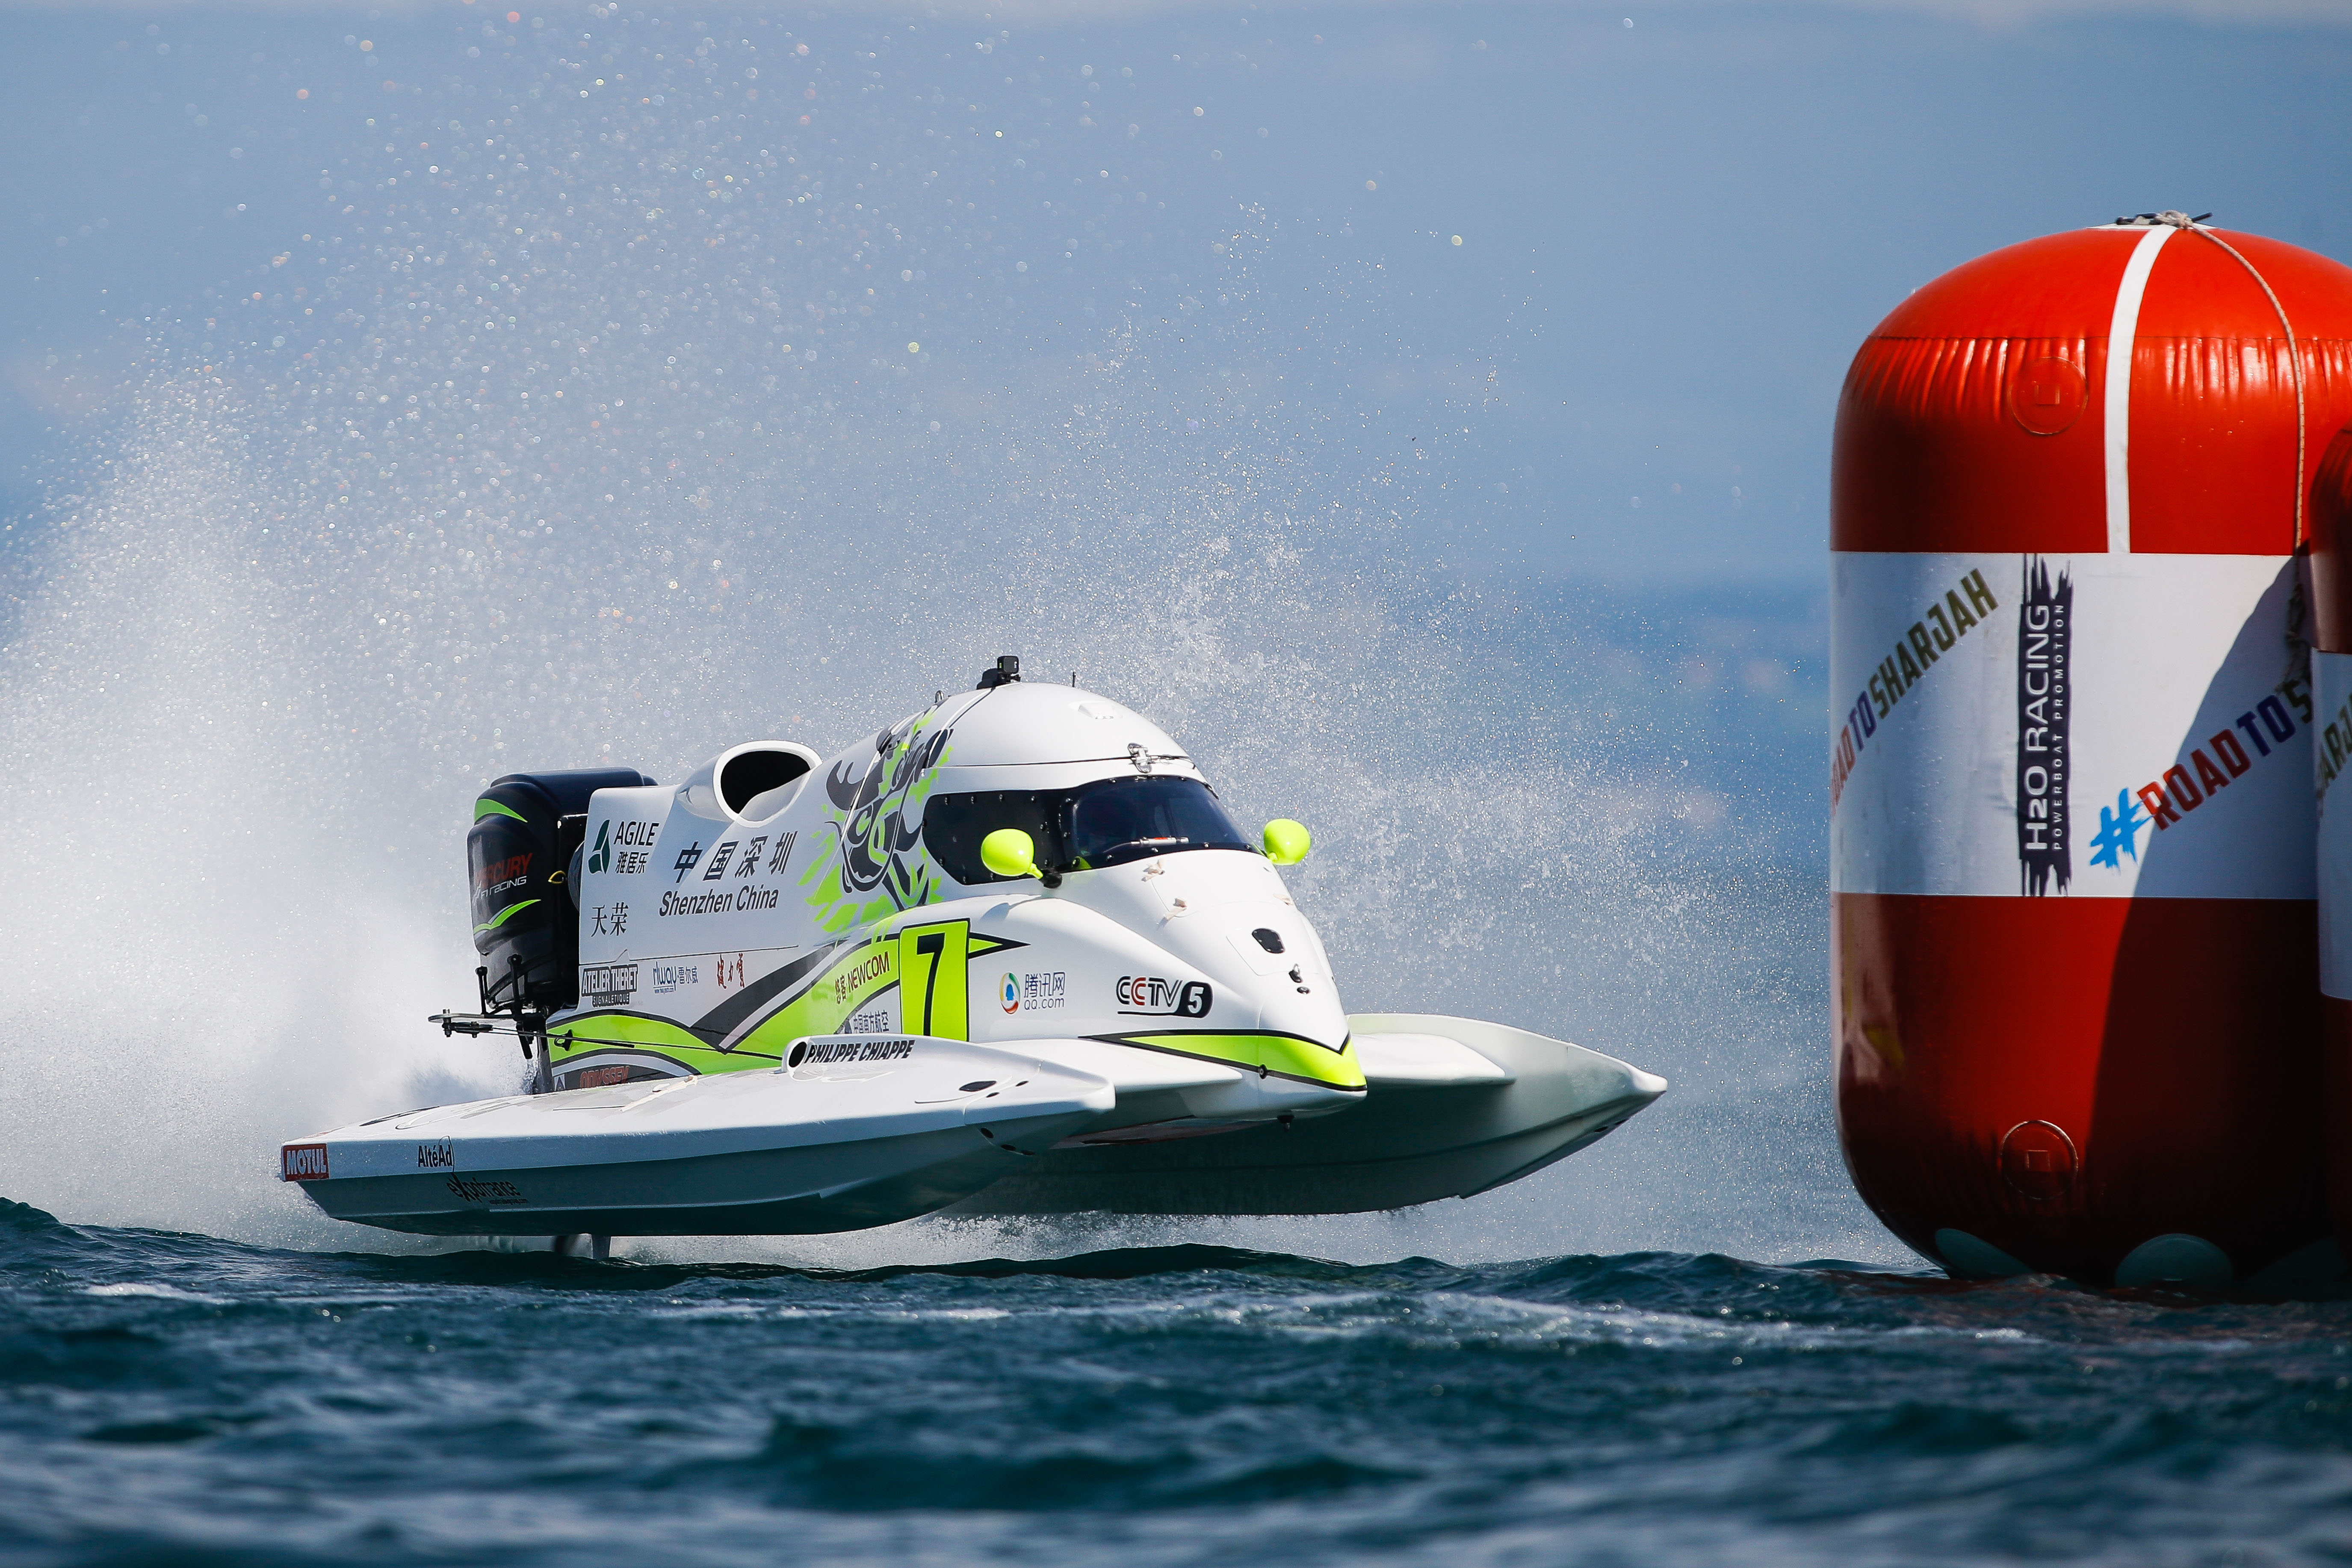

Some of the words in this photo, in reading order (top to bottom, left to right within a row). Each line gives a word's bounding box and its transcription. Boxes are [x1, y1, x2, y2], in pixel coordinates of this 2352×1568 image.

[2054, 605, 2064, 720] PROMOTION
[2025, 605, 2049, 751] RACING
[2053, 734, 2062, 850] POWERBOAT
[613, 821, 660, 846] AGILE
[615, 851, 649, 874] 雅居乐
[674, 830, 798, 884] 中国深圳
[659, 889, 733, 917] Shenzhen
[736, 884, 779, 911] China
[591, 901, 629, 937] 天荣
[582, 969, 611, 994] ATELIER
[611, 966, 638, 992] THERET
[848, 951, 890, 993] NEWCOM
[916, 932, 946, 1036] 7
[1024, 972, 1066, 998] 腾讯网
[593, 993, 629, 1005] SIGNALETIQUE
[1024, 998, 1064, 1010] QQ.com
[804, 1043, 862, 1063] PHILIPPE
[858, 1039, 916, 1061] CHIAPPE
[287, 1149, 326, 1175] MOTUL
